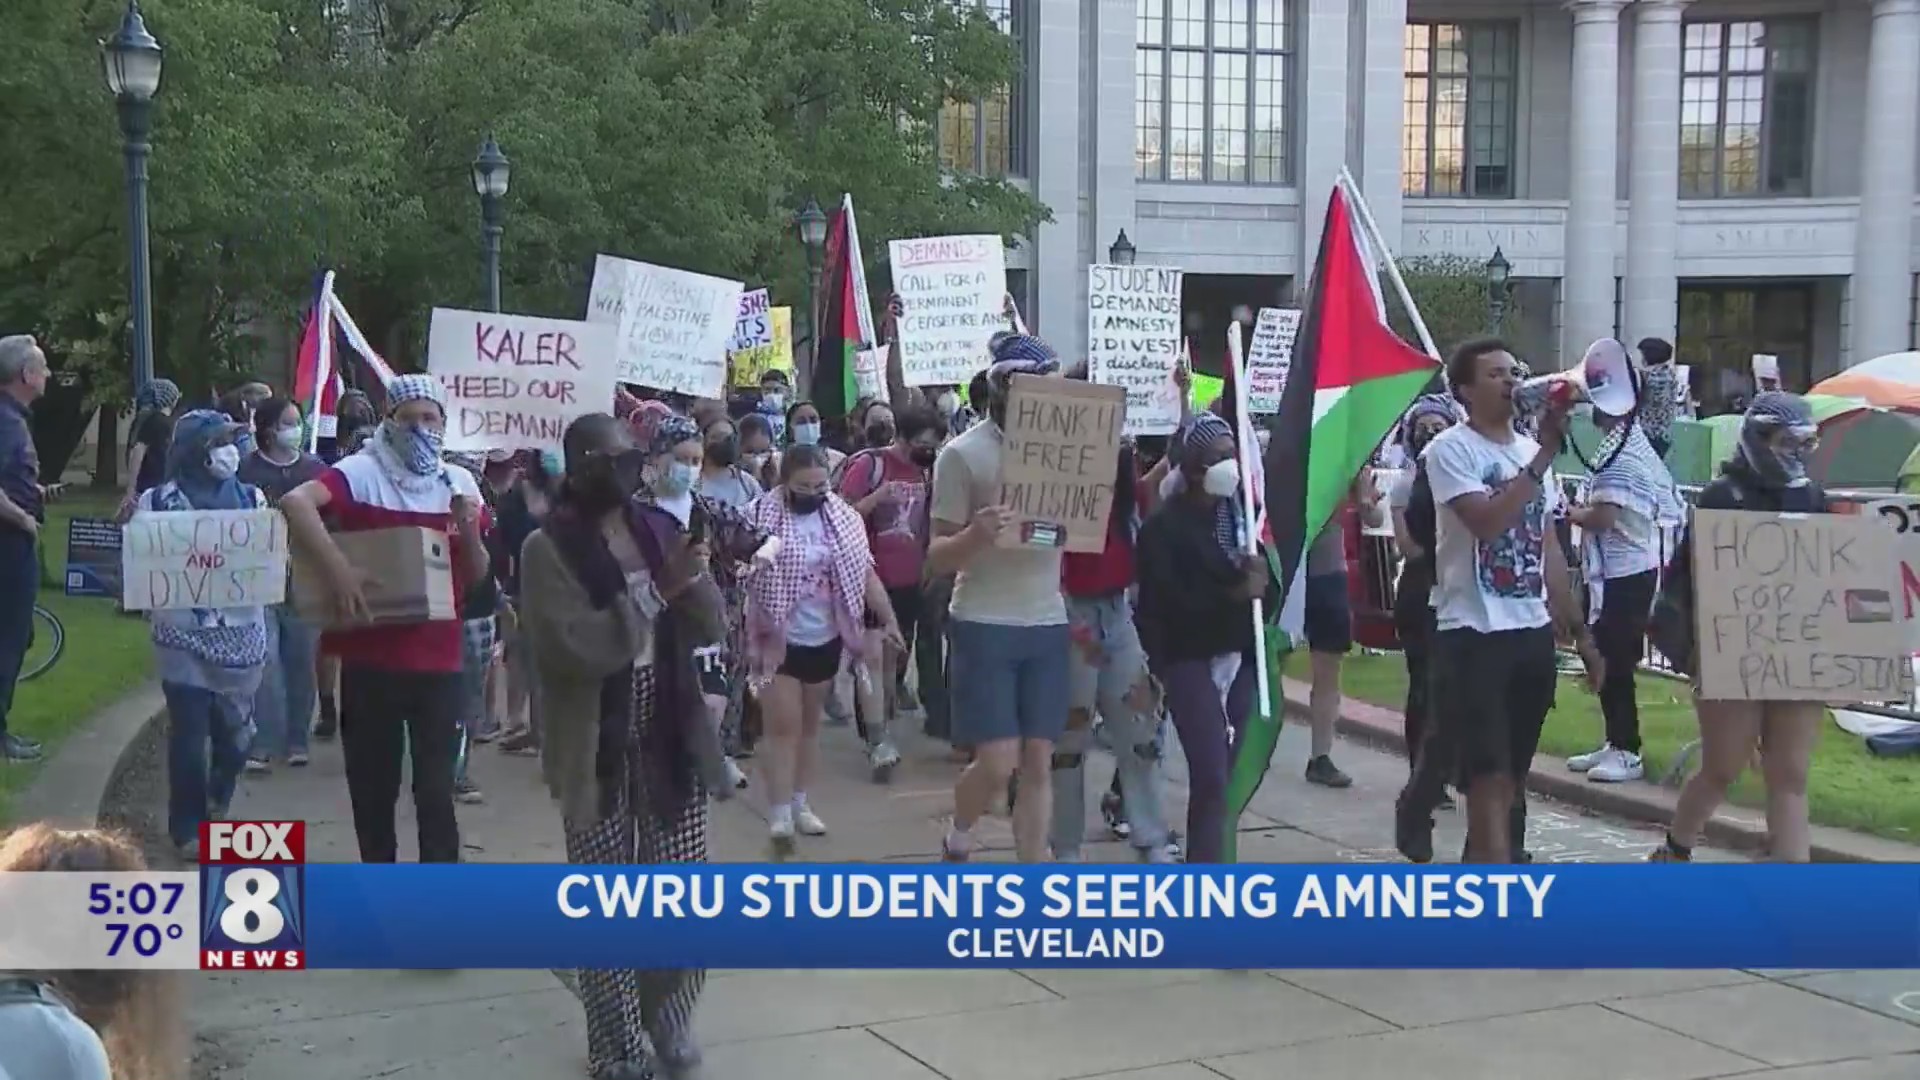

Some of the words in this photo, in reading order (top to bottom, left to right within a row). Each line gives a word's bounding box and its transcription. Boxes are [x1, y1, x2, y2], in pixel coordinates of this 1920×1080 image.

[1091, 266, 1181, 295] STUDENT
[636, 301, 712, 328] PALESTINE
[1090, 294, 1179, 314] DEMANDS
[1104, 315, 1176, 334] AMNESTY
[476, 322, 583, 371] KALER
[1104, 337, 1177, 356] DIVEST
[440, 374, 520, 399] HEED
[527, 378, 577, 405] OUR
[1017, 396, 1089, 438] HONK
[186, 554, 226, 569] AND
[1712, 518, 1861, 578] HONK
[1732, 582, 1795, 612] FOR
[1817, 589, 1838, 613] A
[1712, 612, 1821, 653] FREE
[1739, 652, 1915, 699] PALESTINE
